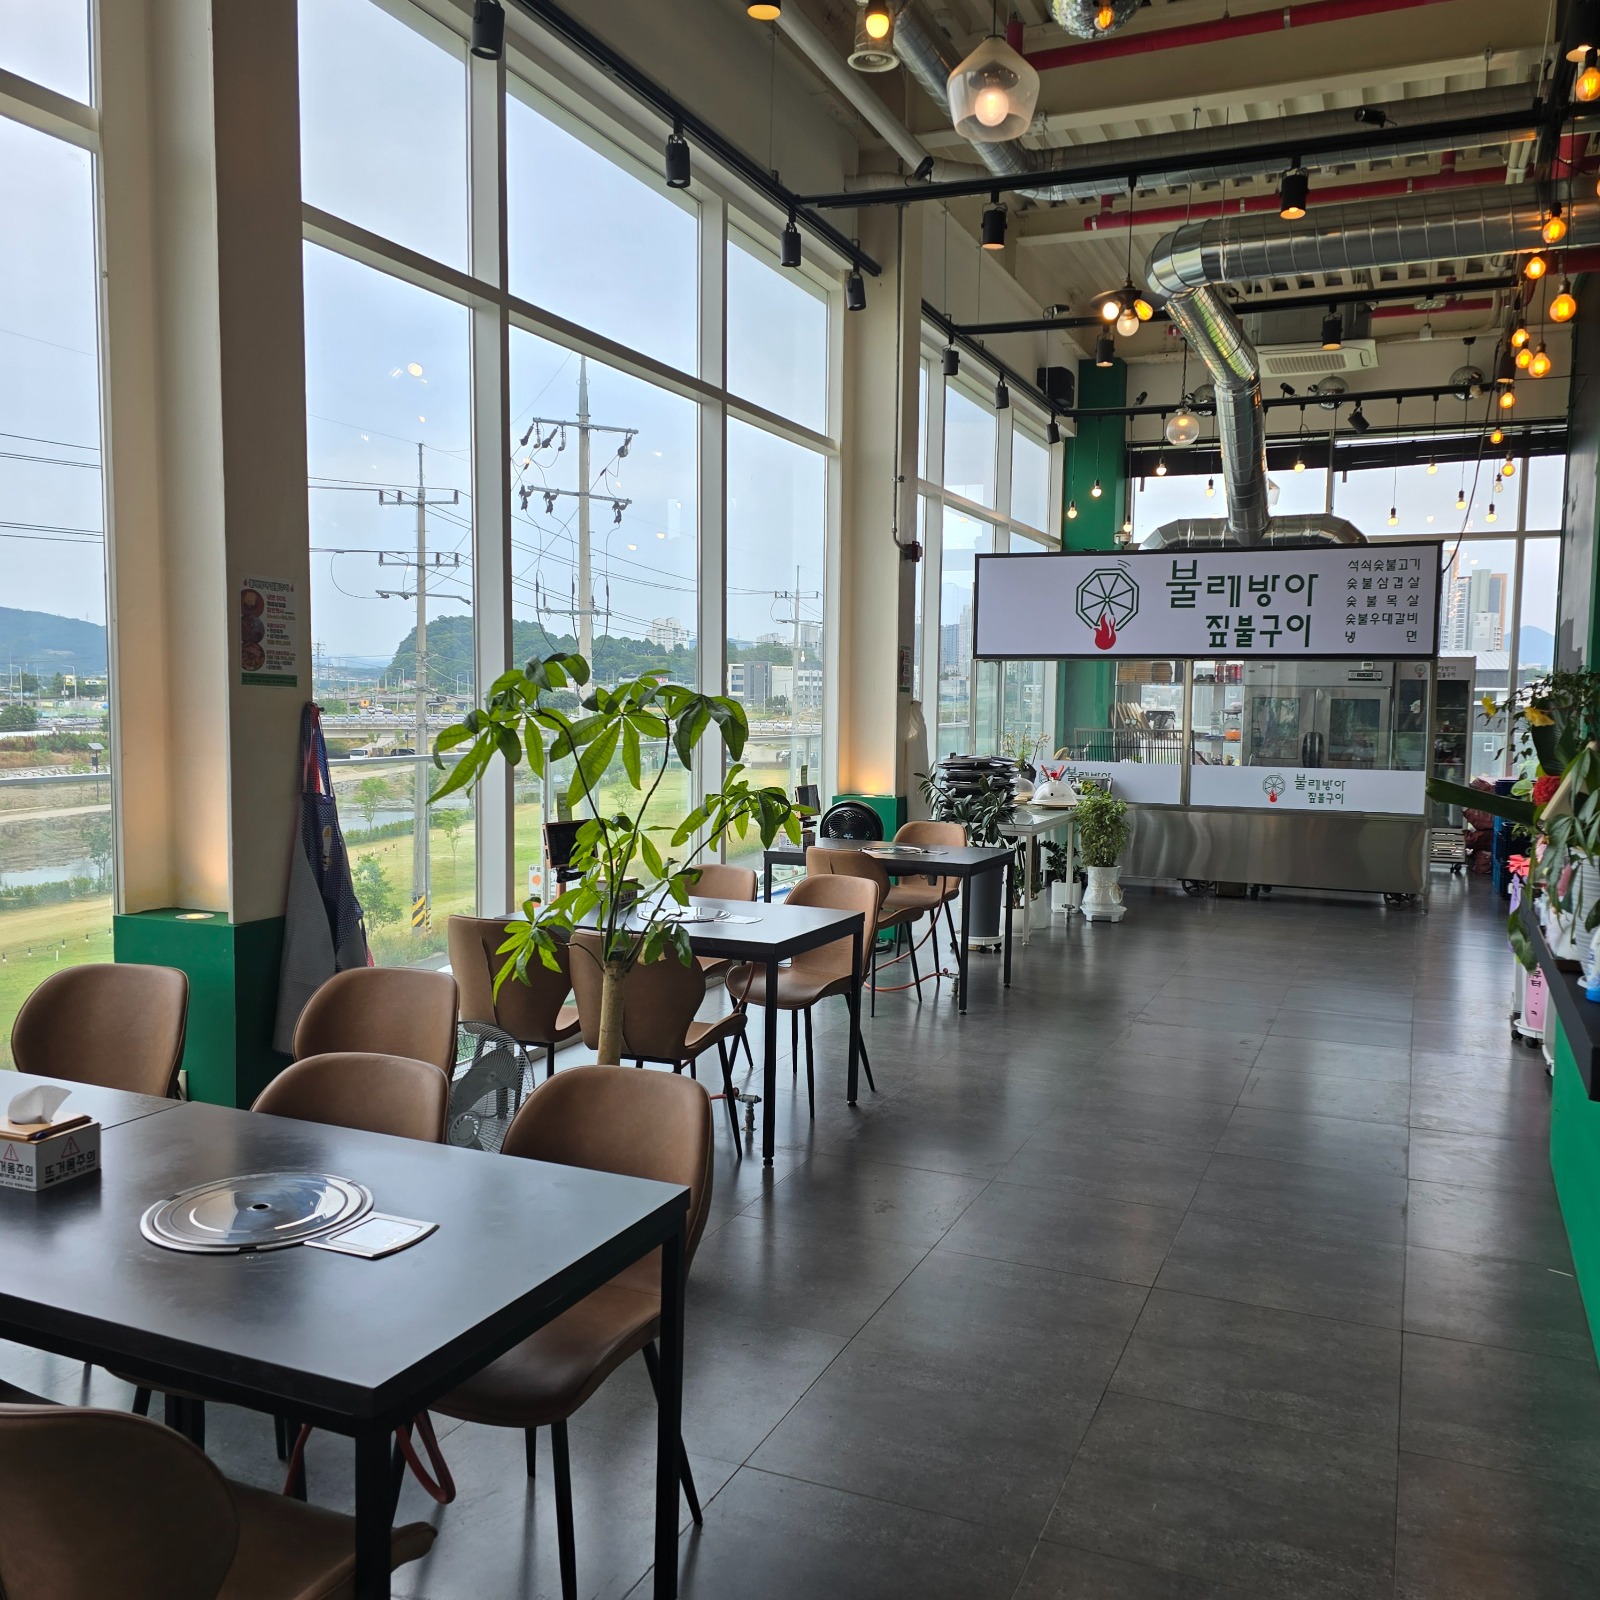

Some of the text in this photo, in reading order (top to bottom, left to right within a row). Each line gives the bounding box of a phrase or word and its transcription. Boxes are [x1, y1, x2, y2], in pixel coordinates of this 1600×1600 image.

[1347, 558, 1421, 572] 석쇠숯불고기
[1166, 560, 1319, 608] 불레방아
[1346, 576, 1421, 590] 숯불삼겹살
[1345, 594, 1420, 608] 숯불목살
[1345, 612, 1418, 626] 숯불우대갈비
[1206, 615, 1311, 648] 짚불구이
[1294, 773, 1346, 791] 불레방아
[1308, 792, 1344, 804] 짚불구이
[0, 1161, 33, 1177] 거움주의
[45, 1149, 95, 1179] 뜨거움주의
